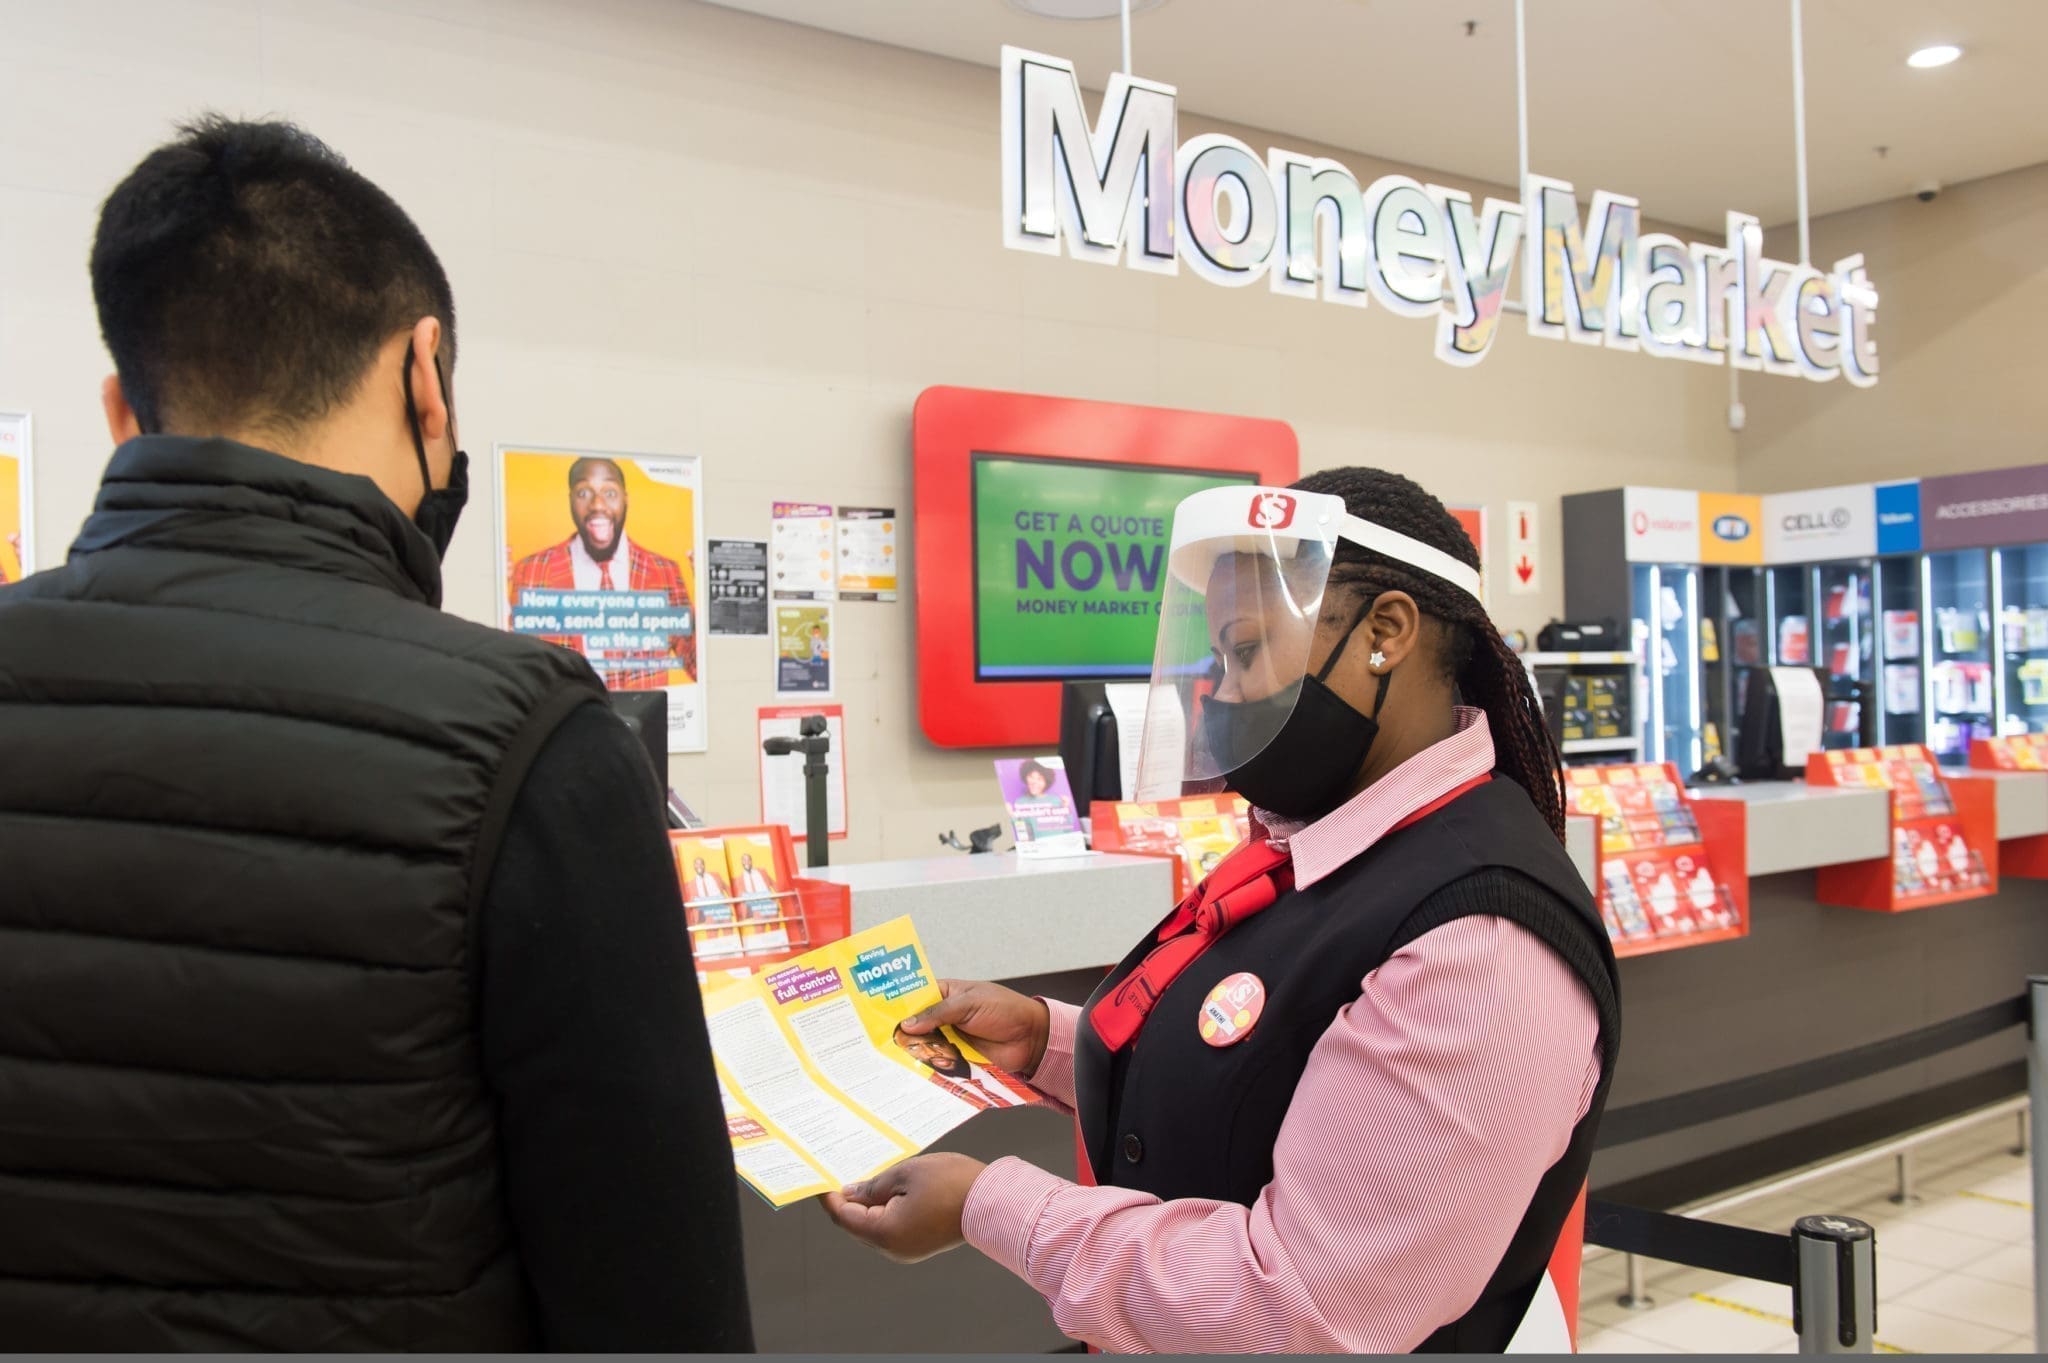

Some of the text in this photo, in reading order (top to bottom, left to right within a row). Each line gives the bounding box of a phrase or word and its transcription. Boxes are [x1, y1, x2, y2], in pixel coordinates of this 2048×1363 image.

[1012, 52, 1879, 385] Money Market
[1015, 511, 1164, 537] GET A QUOTE
[1015, 538, 1166, 592] NOW
[522, 592, 665, 612] Now everyone can
[1016, 599, 1078, 615] MONEY
[1083, 600, 1148, 616] MARKET
[514, 613, 690, 632] save, send and spend
[589, 633, 665, 650] on the go.
[859, 948, 885, 962] Saving
[857, 953, 912, 984] money
[777, 969, 838, 1000] full control
[868, 972, 916, 995] shouldn't cost
[886, 979, 927, 999] you money.
